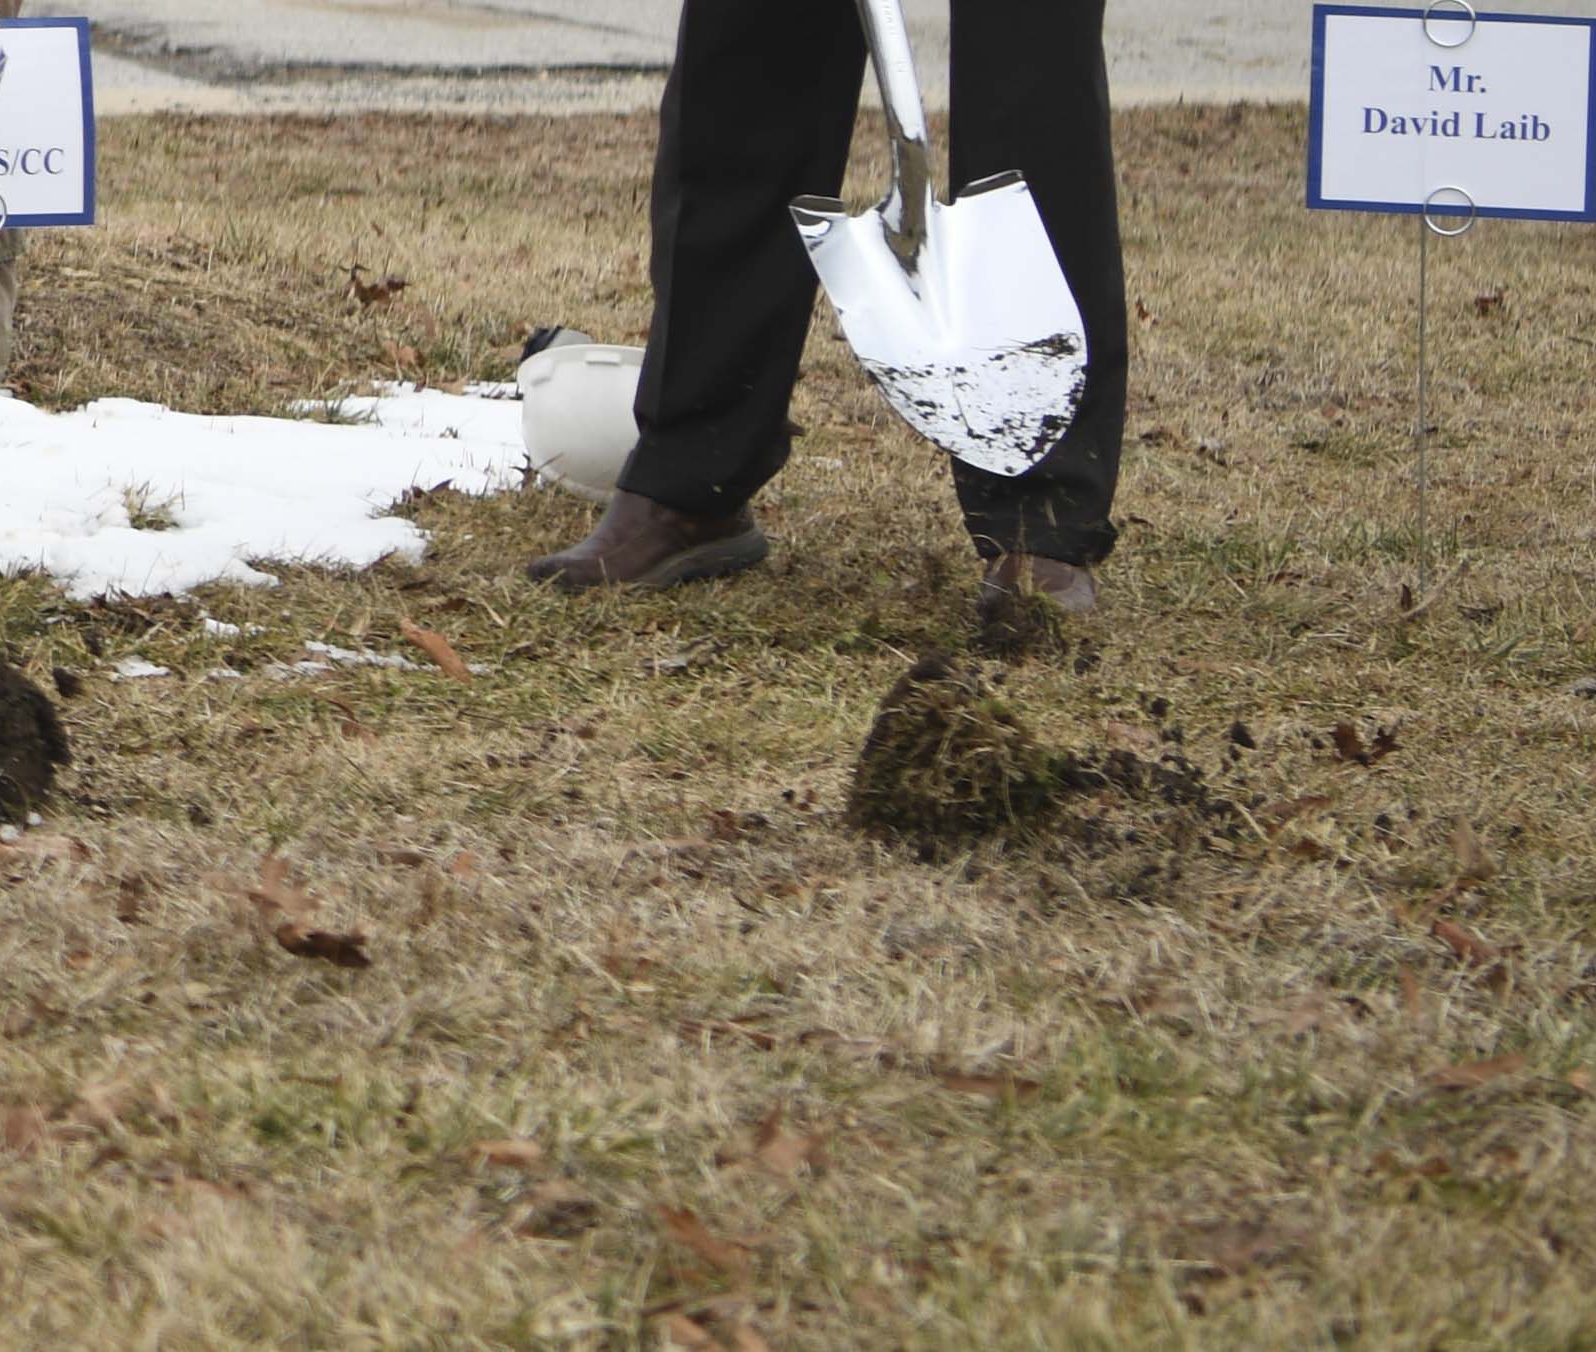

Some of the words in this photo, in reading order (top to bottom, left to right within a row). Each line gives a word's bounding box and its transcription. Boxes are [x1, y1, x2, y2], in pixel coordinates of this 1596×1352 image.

[1428, 64, 1488, 94] Mr.
[1362, 106, 1461, 138] David
[1474, 111, 1552, 143] Laib
